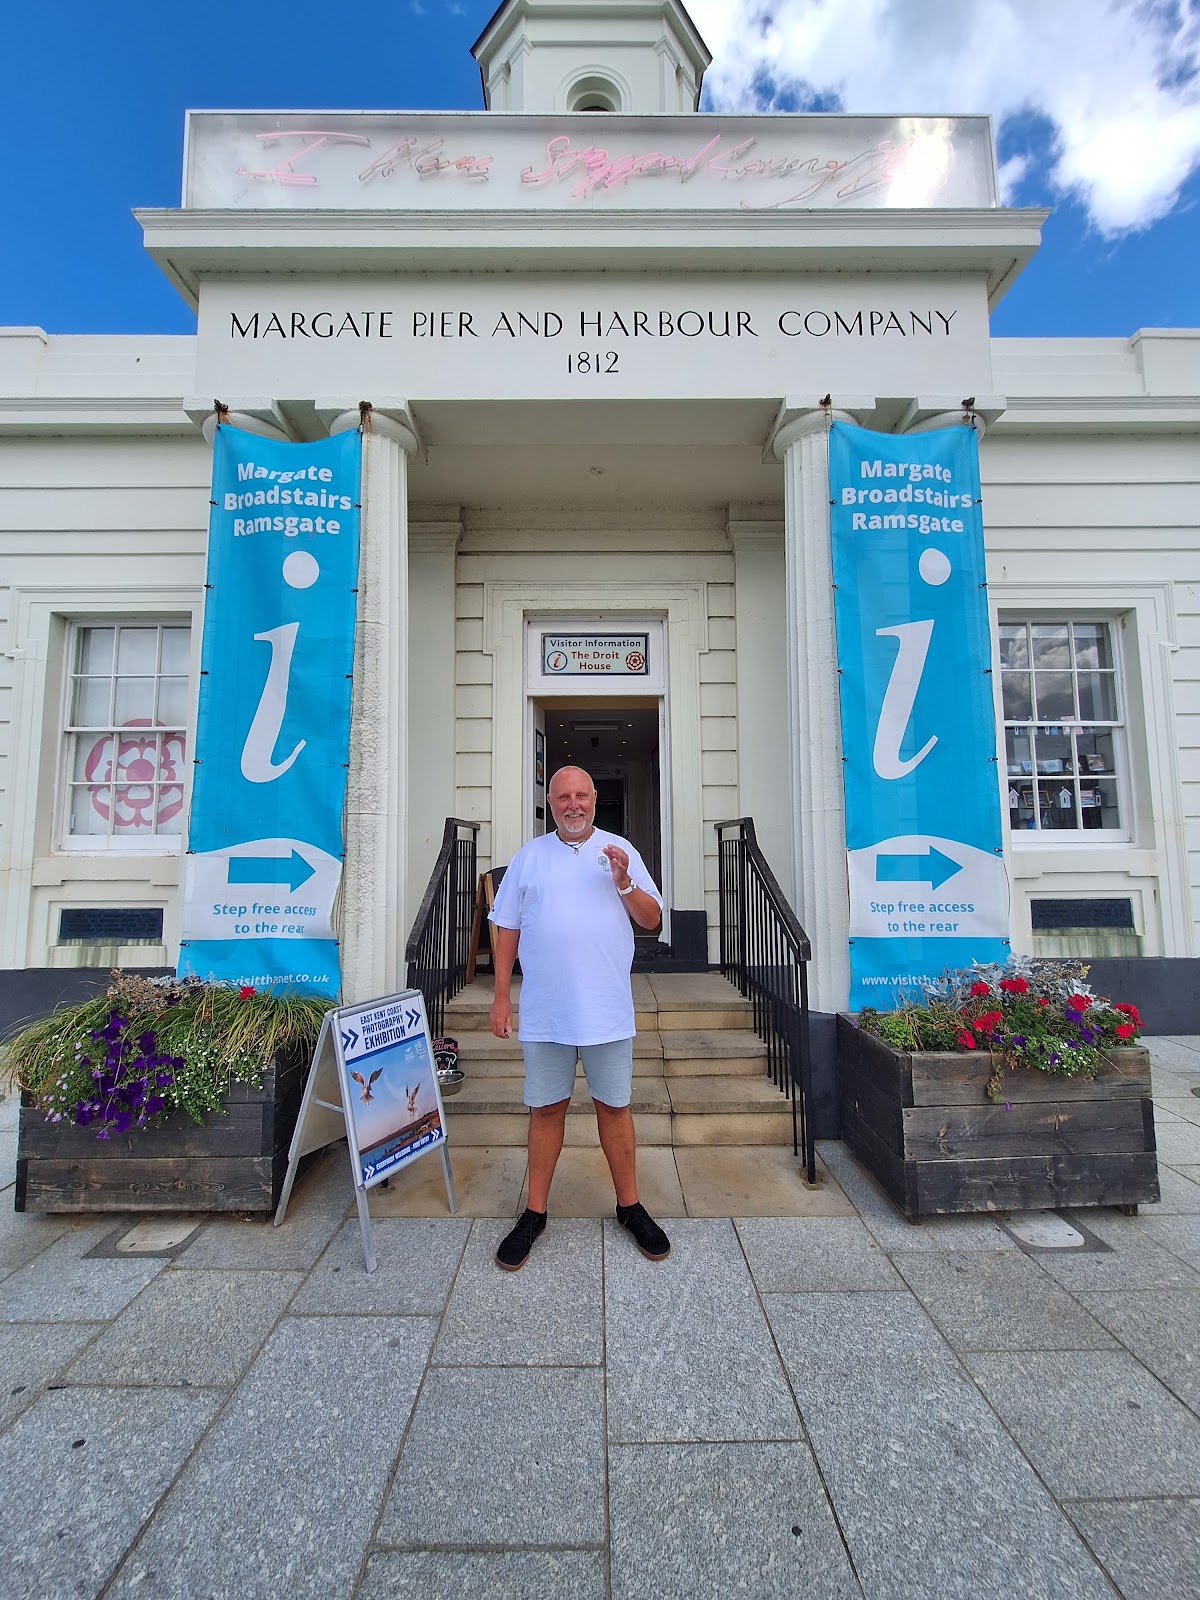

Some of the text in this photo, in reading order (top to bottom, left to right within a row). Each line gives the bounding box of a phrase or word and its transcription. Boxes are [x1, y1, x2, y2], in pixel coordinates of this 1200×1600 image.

[230, 310, 957, 339] MARGATE PIER AND HARBOUR COMPANY
[567, 351, 620, 374] 1812
[237, 462, 333, 484] Margate
[861, 460, 952, 484] Margate
[223, 485, 352, 511] Broadstairs
[841, 484, 973, 509] Broadstairs
[233, 515, 341, 537] Ramsgate
[852, 512, 964, 535] Ramsgate
[550, 639, 641, 648] Visitor Information
[570, 651, 620, 660] The Droit
[579, 662, 612, 670] House
[212, 903, 317, 918] Step free access
[870, 901, 975, 916] Step free access
[234, 922, 305, 934] to the rear
[887, 920, 959, 932] to the rear
[360, 1004, 402, 1025] EAST KENT COAST
[361, 1013, 404, 1036] PHOTOGRAPHY
[364, 1024, 406, 1051] EXHIBITION
